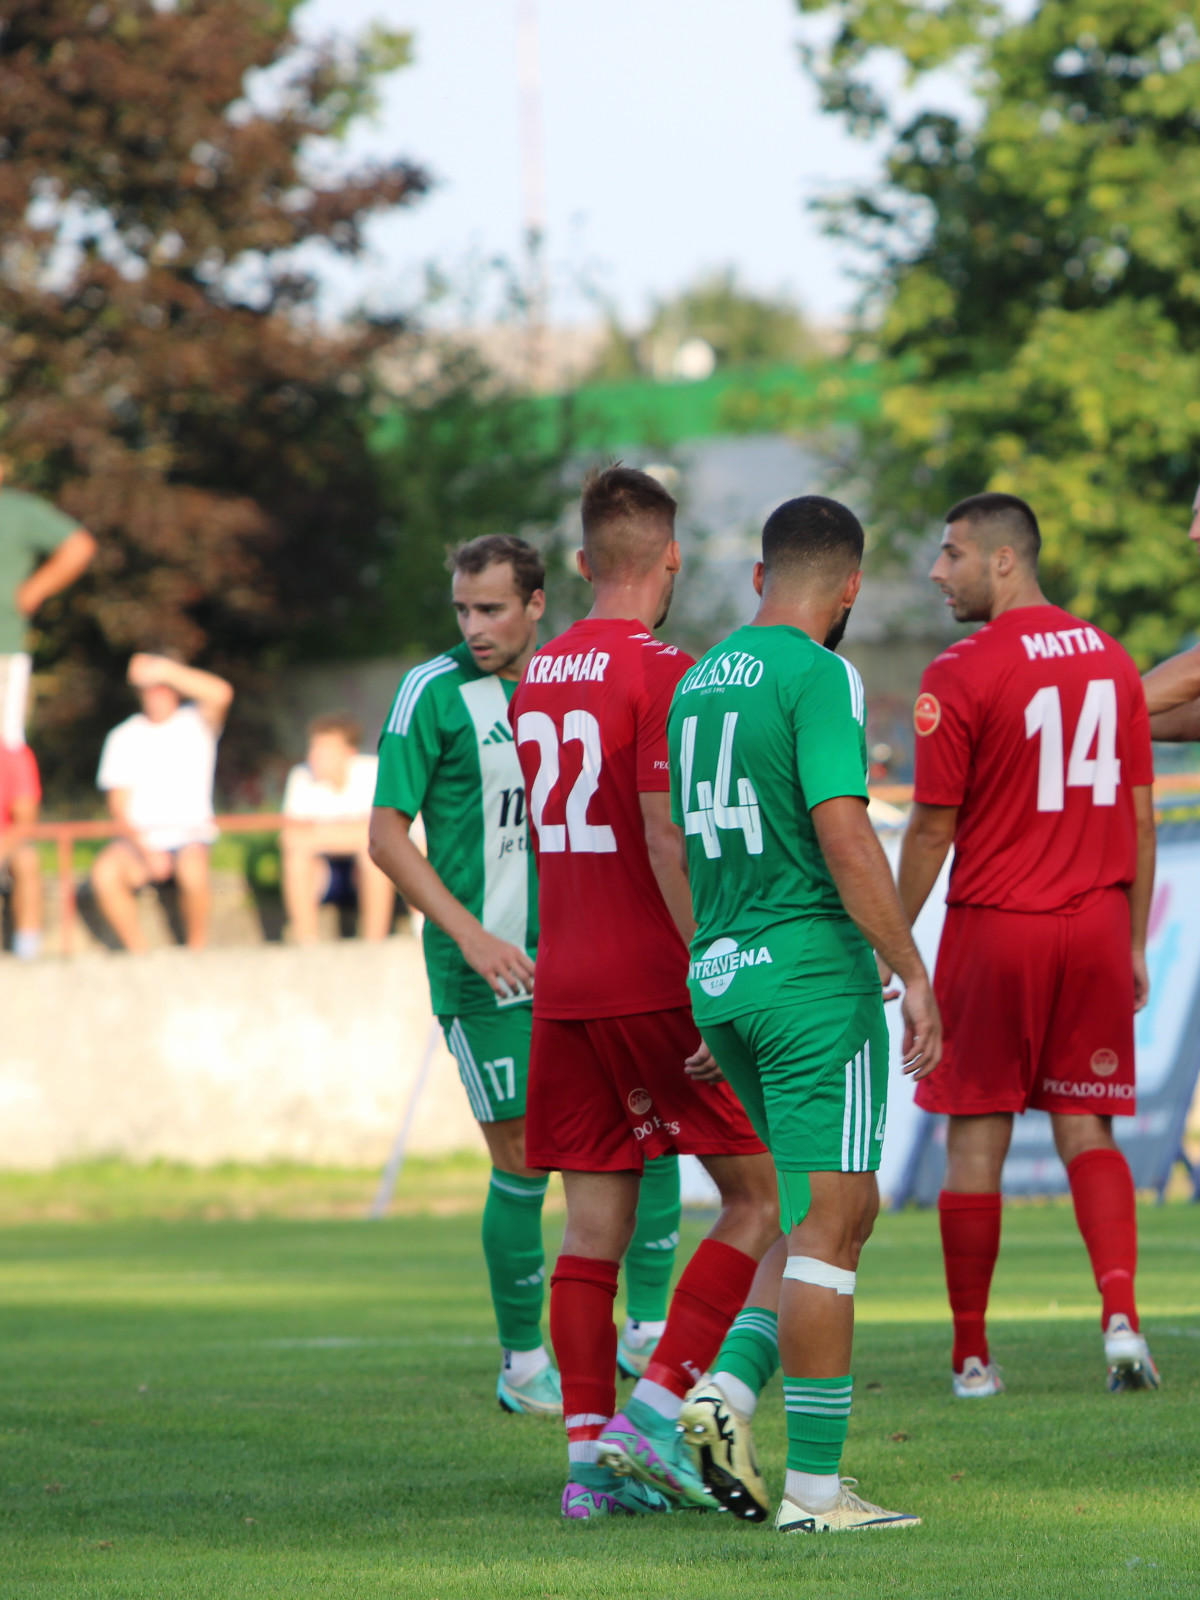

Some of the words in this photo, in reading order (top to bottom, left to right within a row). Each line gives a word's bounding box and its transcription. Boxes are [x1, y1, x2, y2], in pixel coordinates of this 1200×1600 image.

[525, 646, 610, 685] KRAMÁR
[1020, 626, 1106, 662] MATTA
[681, 650, 764, 695] GLASKO
[1023, 678, 1122, 813] 14
[517, 709, 618, 853] 22
[679, 711, 764, 860] 44
[483, 1056, 516, 1102] 17
[1043, 1079, 1106, 1098] PECADO
